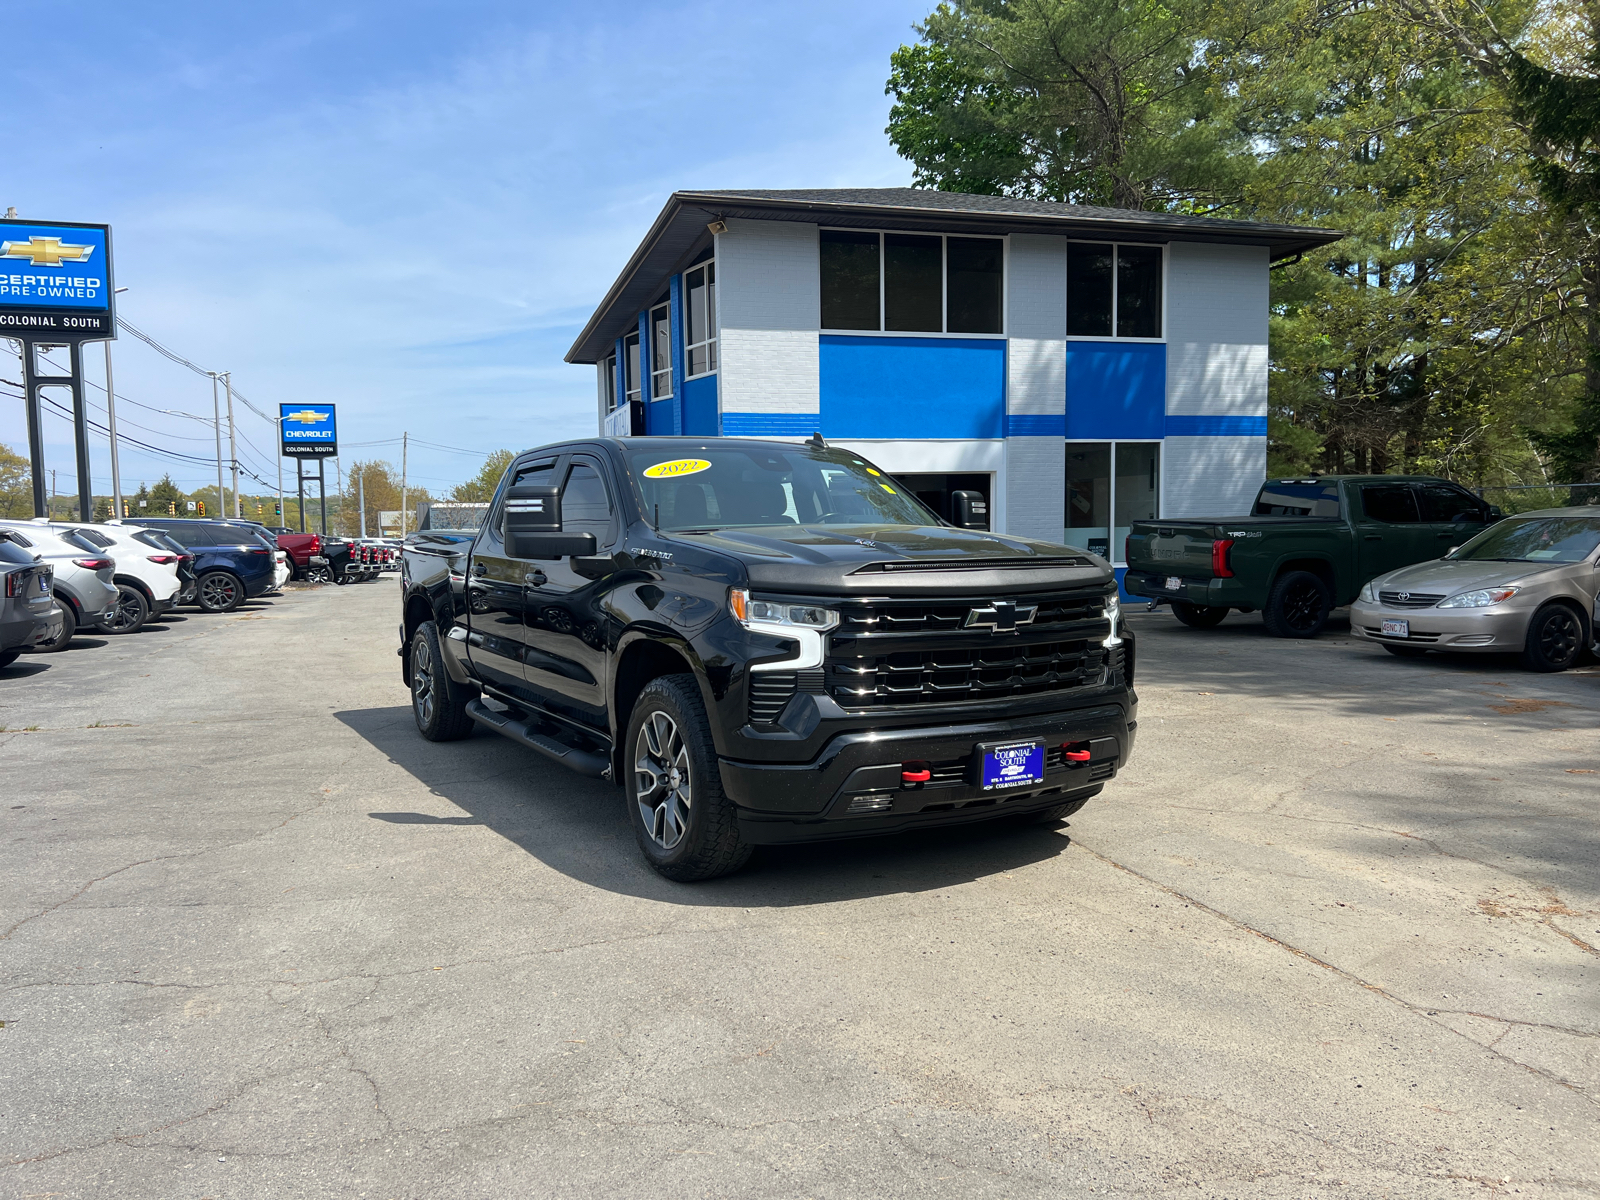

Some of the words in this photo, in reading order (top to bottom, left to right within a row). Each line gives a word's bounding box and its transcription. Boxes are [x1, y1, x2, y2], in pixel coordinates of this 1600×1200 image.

[0, 274, 101, 288] CERTIFIED
[1, 286, 96, 298] PRE-OWNED
[0, 315, 57, 327] COLONIAL
[63, 317, 100, 328] SOUTH
[657, 461, 700, 476] 2022
[1142, 548, 1191, 559] TUNDRA
[994, 748, 1032, 760] COLONIAL
[999, 756, 1026, 767] SOUTH
